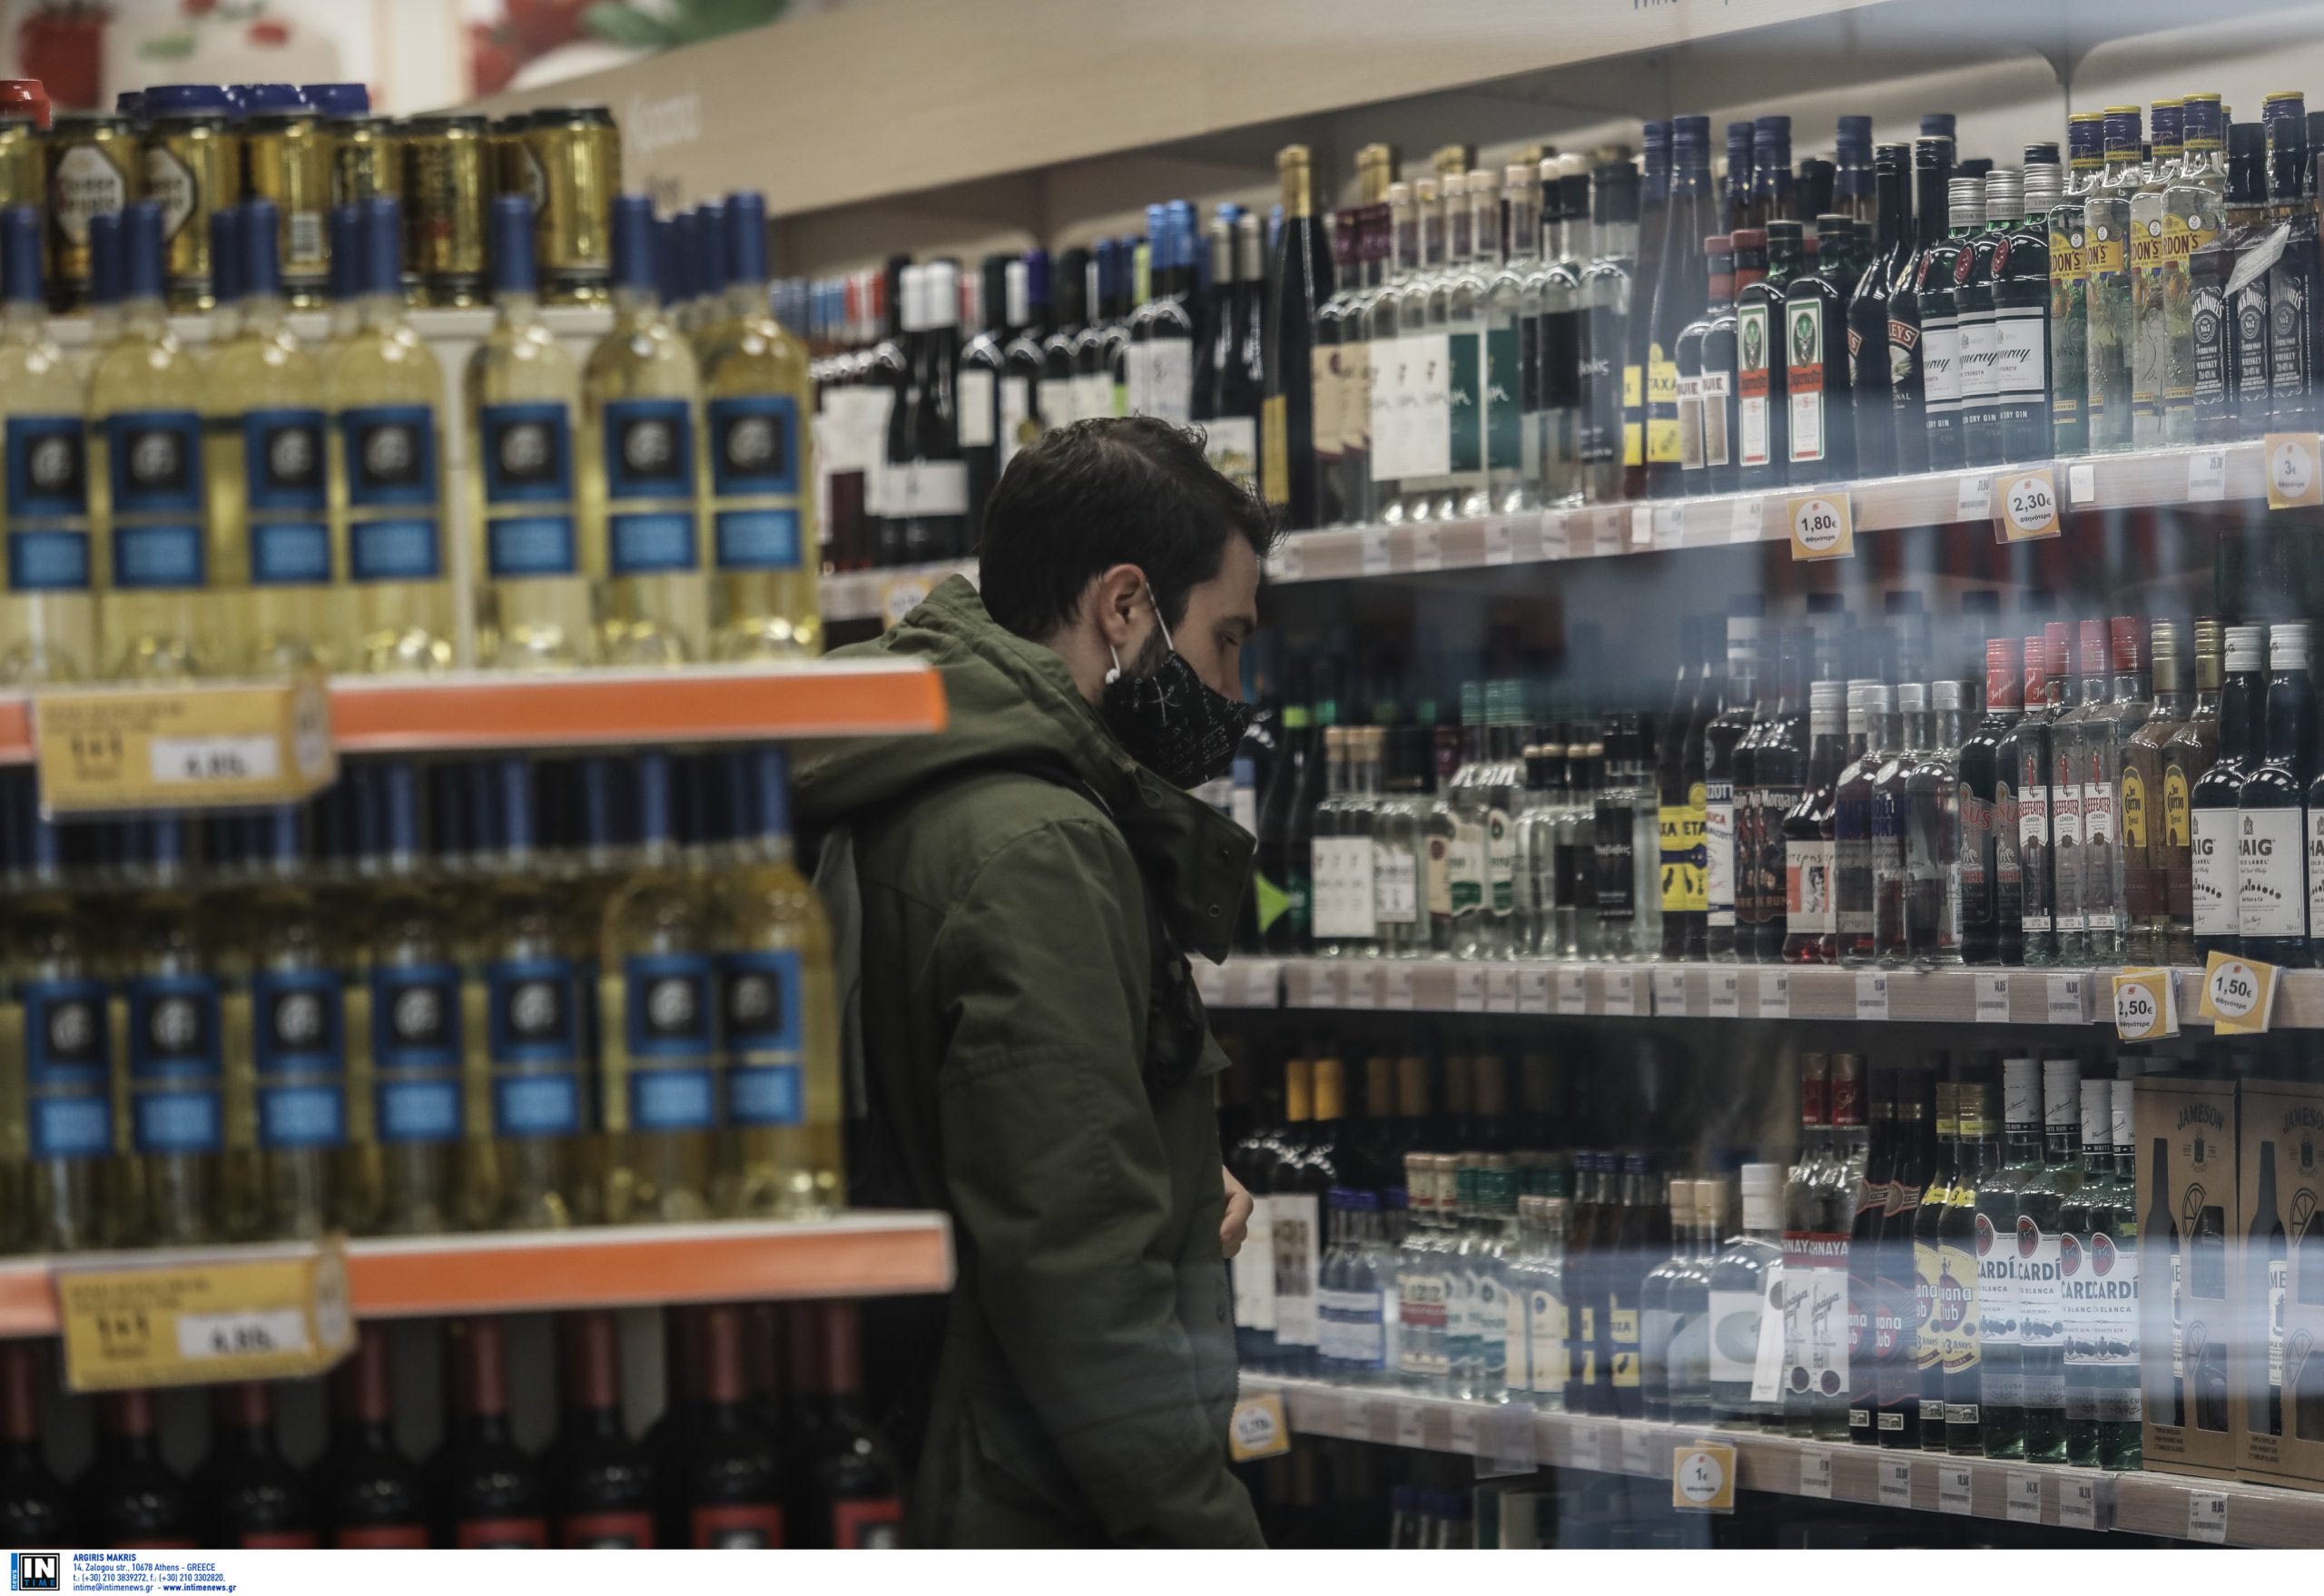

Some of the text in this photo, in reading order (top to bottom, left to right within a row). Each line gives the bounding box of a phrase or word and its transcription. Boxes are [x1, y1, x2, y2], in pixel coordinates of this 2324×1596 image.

[1983, 412, 1997, 422] GIN
[2014, 409, 2028, 419] GIN
[2013, 492, 2053, 513] 2,30€
[1800, 514, 1837, 532] 1,80€
[2019, 799, 2045, 820] BEEFEATER
[2053, 799, 2080, 820] BEEFEATER
[2085, 796, 2111, 816] BEEFEATER
[2239, 838, 2272, 857] HAIG
[2215, 976, 2252, 1000] 1,50€
[2119, 1000, 2153, 1017] 2,50€
[2178, 1103, 2224, 1132] JAMESON
[2282, 1107, 2324, 1135] JAMESO
[2025, 1287, 2054, 1296] BLANCA
[2100, 1305, 2132, 1314] BLANCA
[1945, 1338, 1952, 1355] 3
